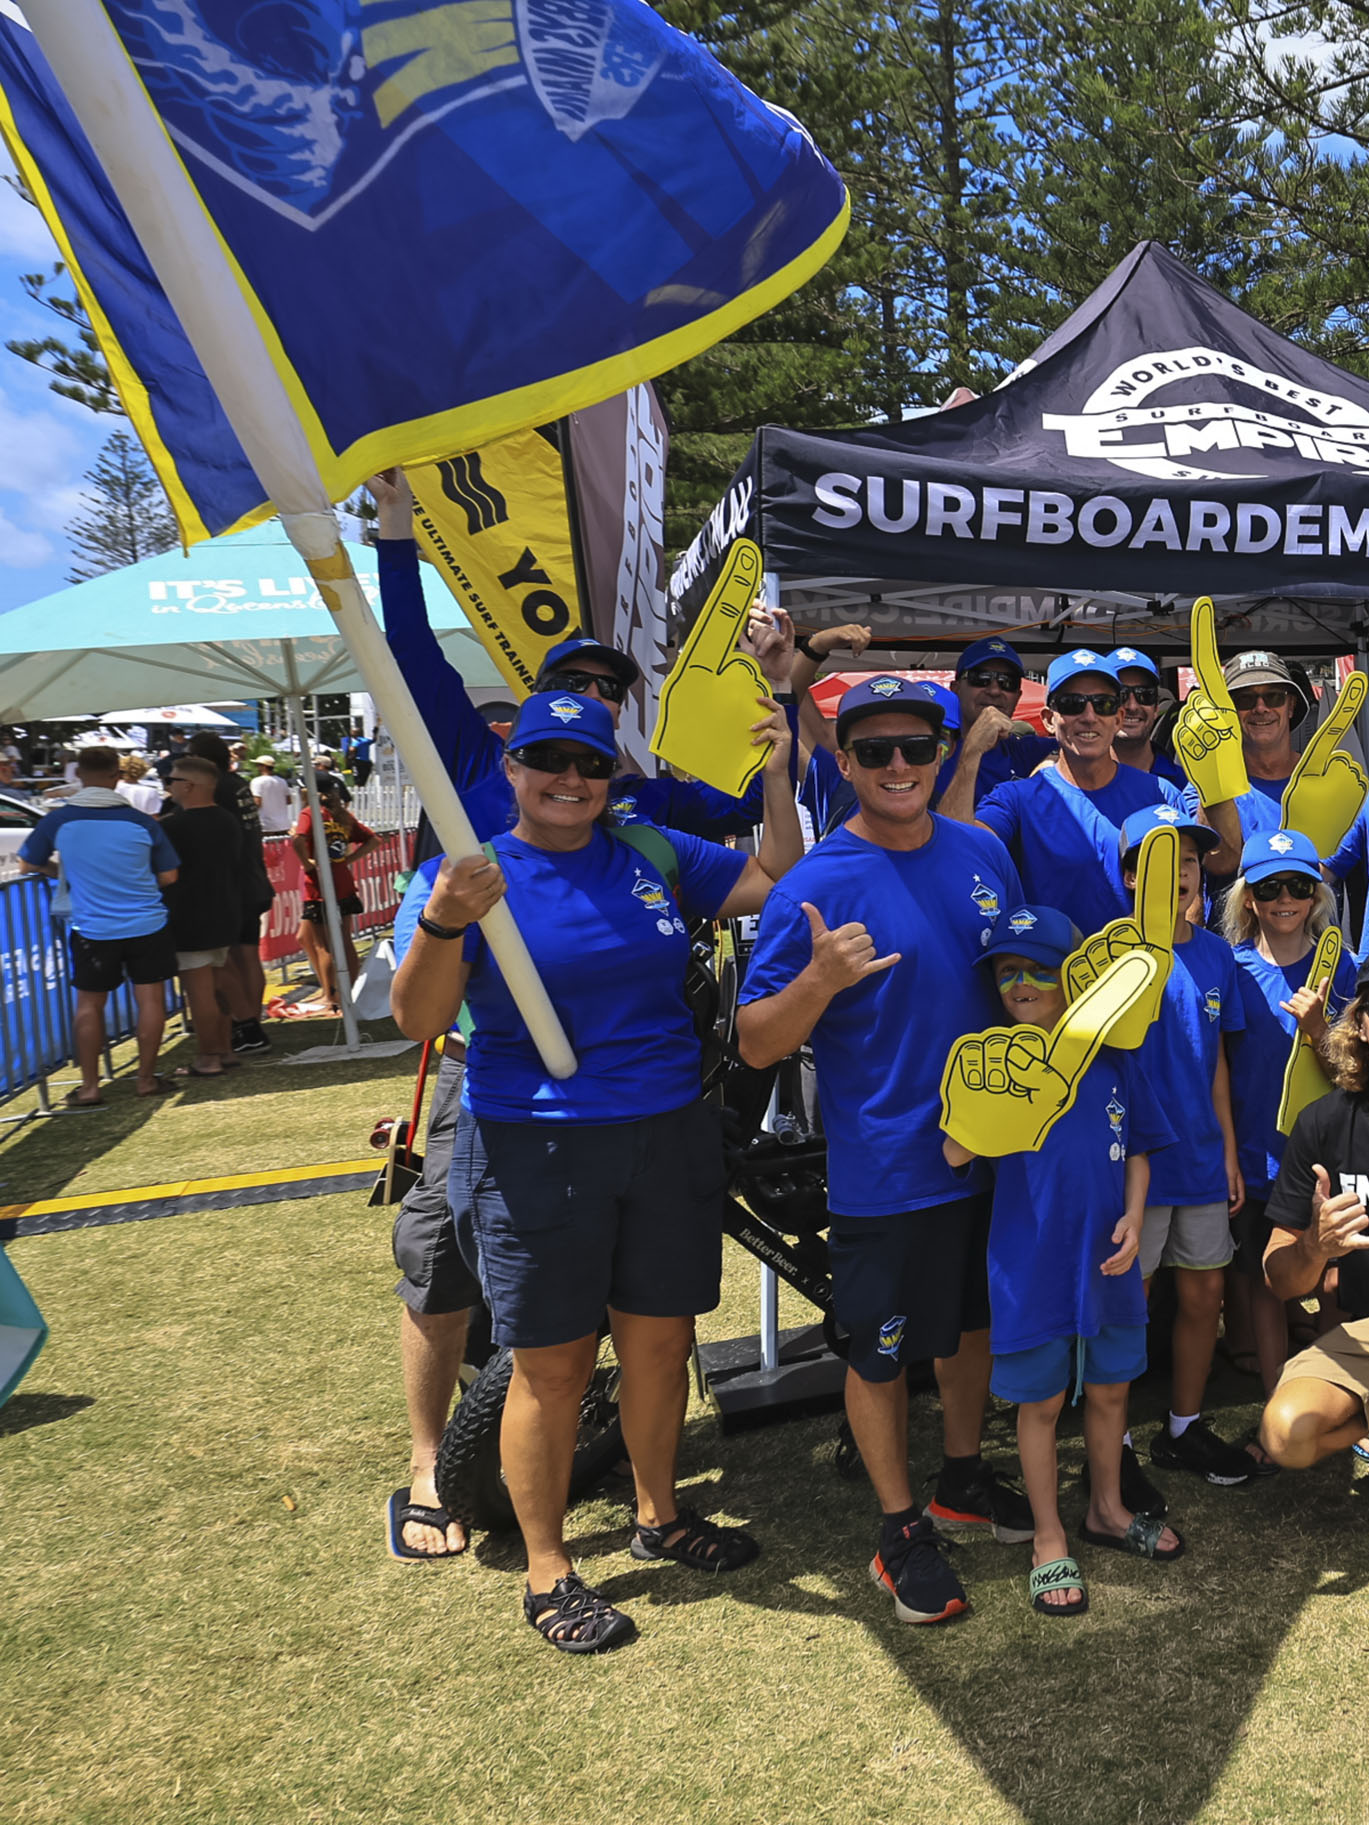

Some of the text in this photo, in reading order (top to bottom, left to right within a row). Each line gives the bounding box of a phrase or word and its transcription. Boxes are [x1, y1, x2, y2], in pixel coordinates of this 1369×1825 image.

[1109, 354, 1344, 417] WORLD'S BEST
[148, 578, 247, 600] IT'S
[420, 516, 473, 592] ULTIMATE
[468, 590, 499, 632] SURF
[497, 545, 583, 642] YO
[151, 603, 181, 614] in
